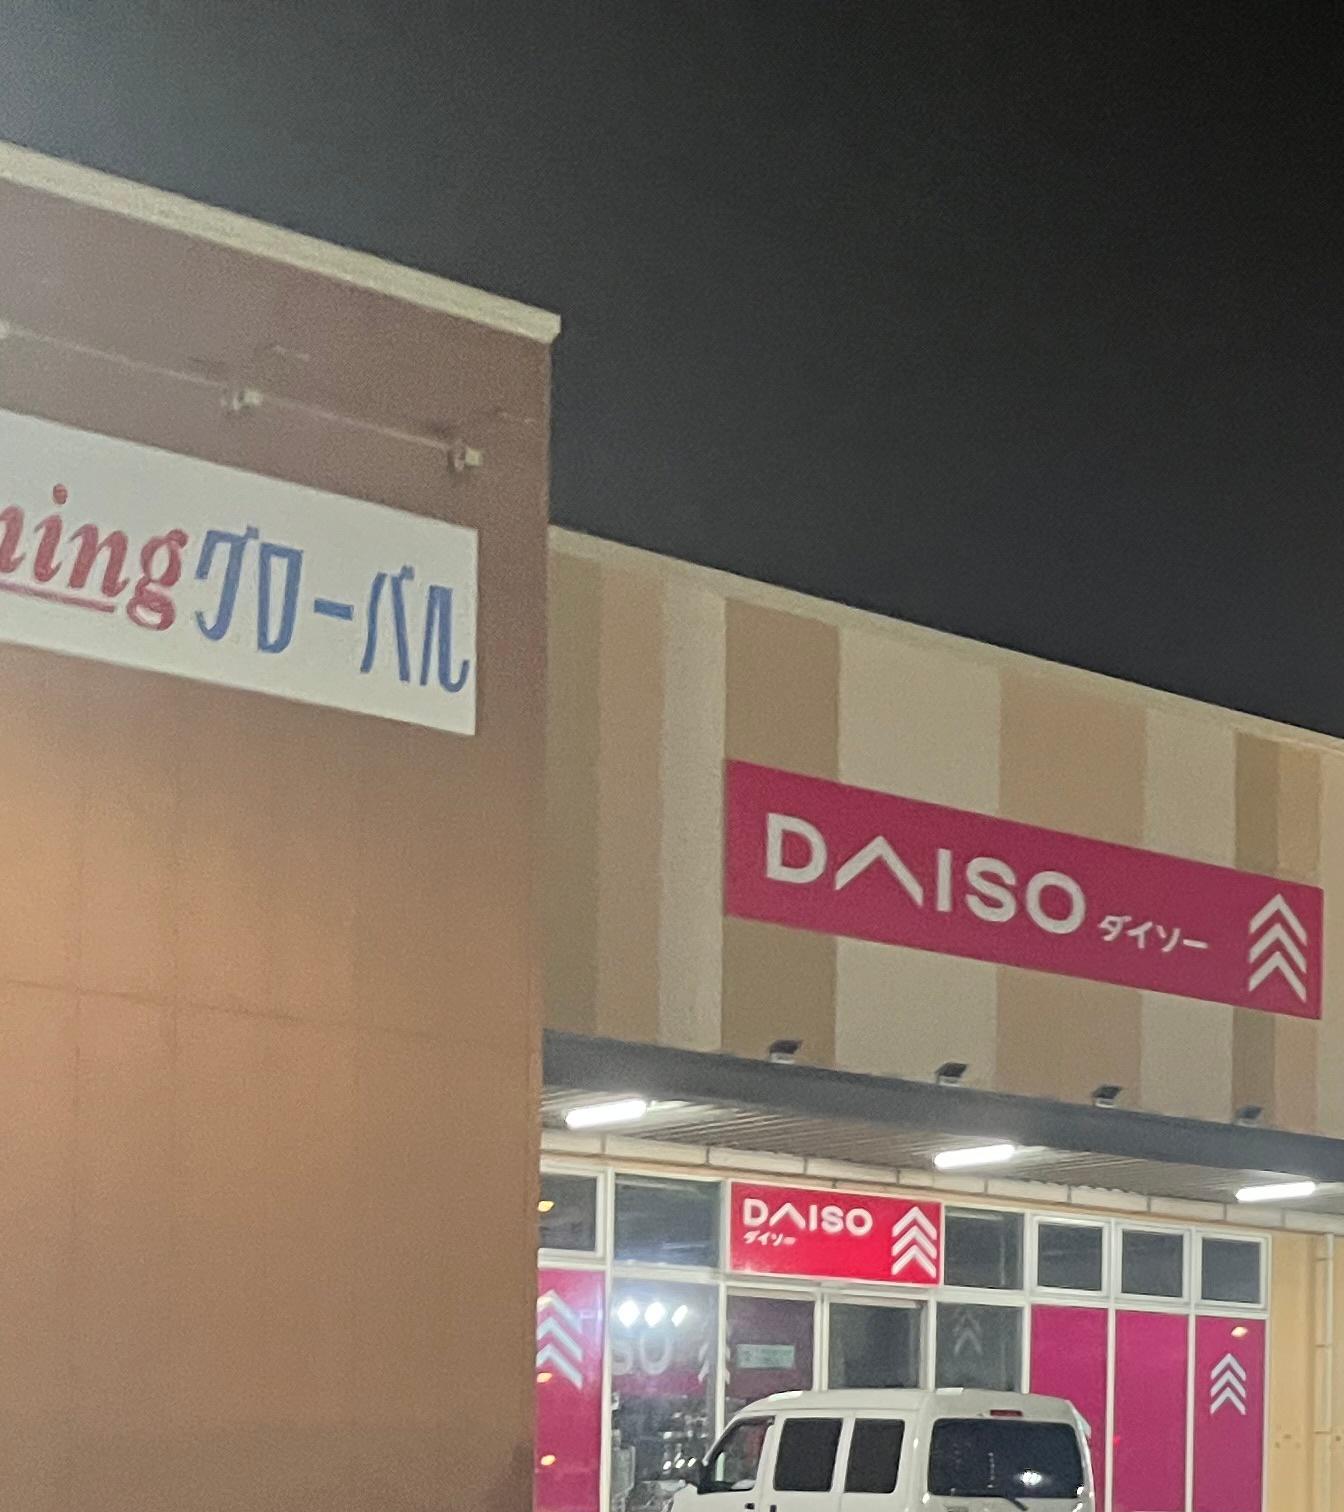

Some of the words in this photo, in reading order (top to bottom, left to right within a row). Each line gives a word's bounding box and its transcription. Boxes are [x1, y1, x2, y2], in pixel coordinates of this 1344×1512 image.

[194, 526, 470, 693] グローバル
[766, 812, 1087, 934] DAISO
[1099, 915, 1208, 953] ダイソー
[743, 1198, 873, 1236] DAISO
[743, 1230, 797, 1246] ダイソー
